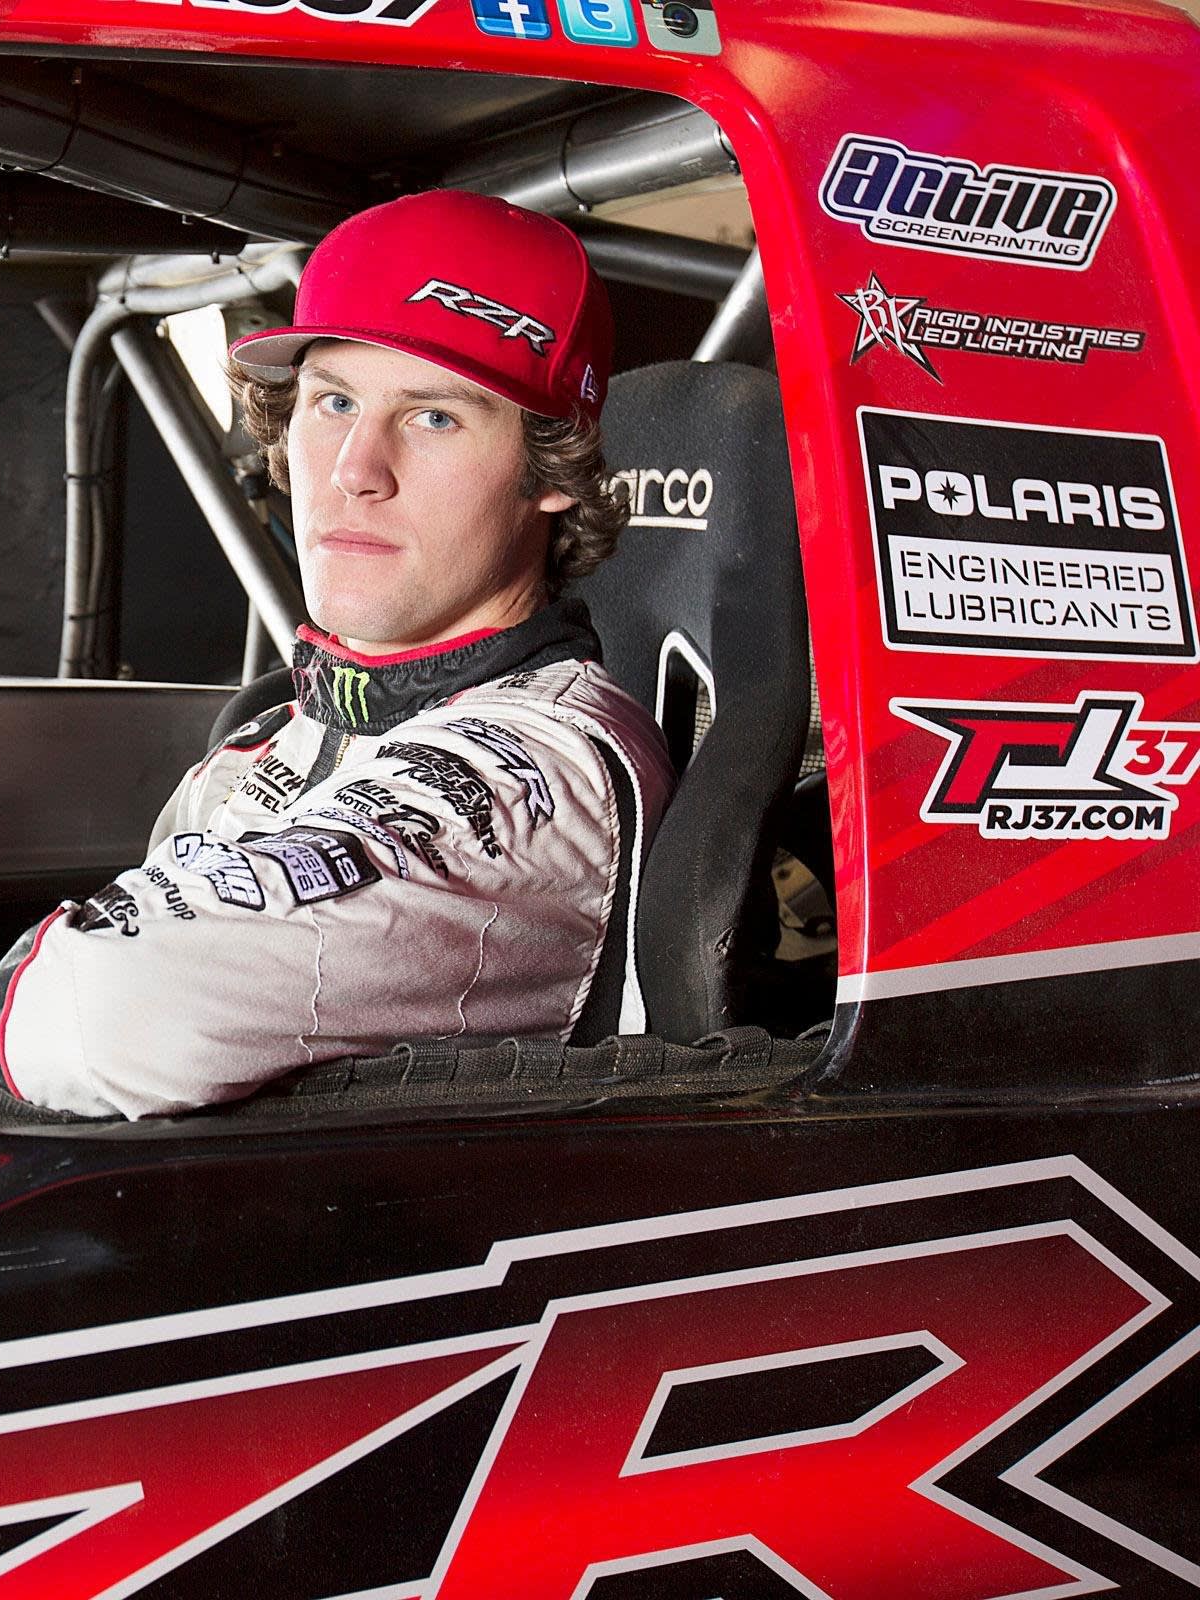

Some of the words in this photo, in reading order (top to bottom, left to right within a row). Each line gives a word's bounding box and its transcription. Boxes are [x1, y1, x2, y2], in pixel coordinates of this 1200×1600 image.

[875, 217, 1081, 256] SCREENPRINTING
[405, 277, 557, 357] RZR
[910, 307, 981, 331] RIGID
[984, 317, 1140, 351] INDUSTRIES
[906, 322, 960, 345] LED
[964, 334, 1085, 360] LIGHTING
[878, 464, 1166, 530] POLARIS
[900, 550, 1165, 593] ENGINEERED
[905, 589, 1172, 631] LUBRICANTS
[1123, 729, 1200, 776] 37
[240, 780, 280, 815] HOTEL
[333, 791, 373, 817] HOTEL
[986, 804, 1166, 831] RJ37.COM
